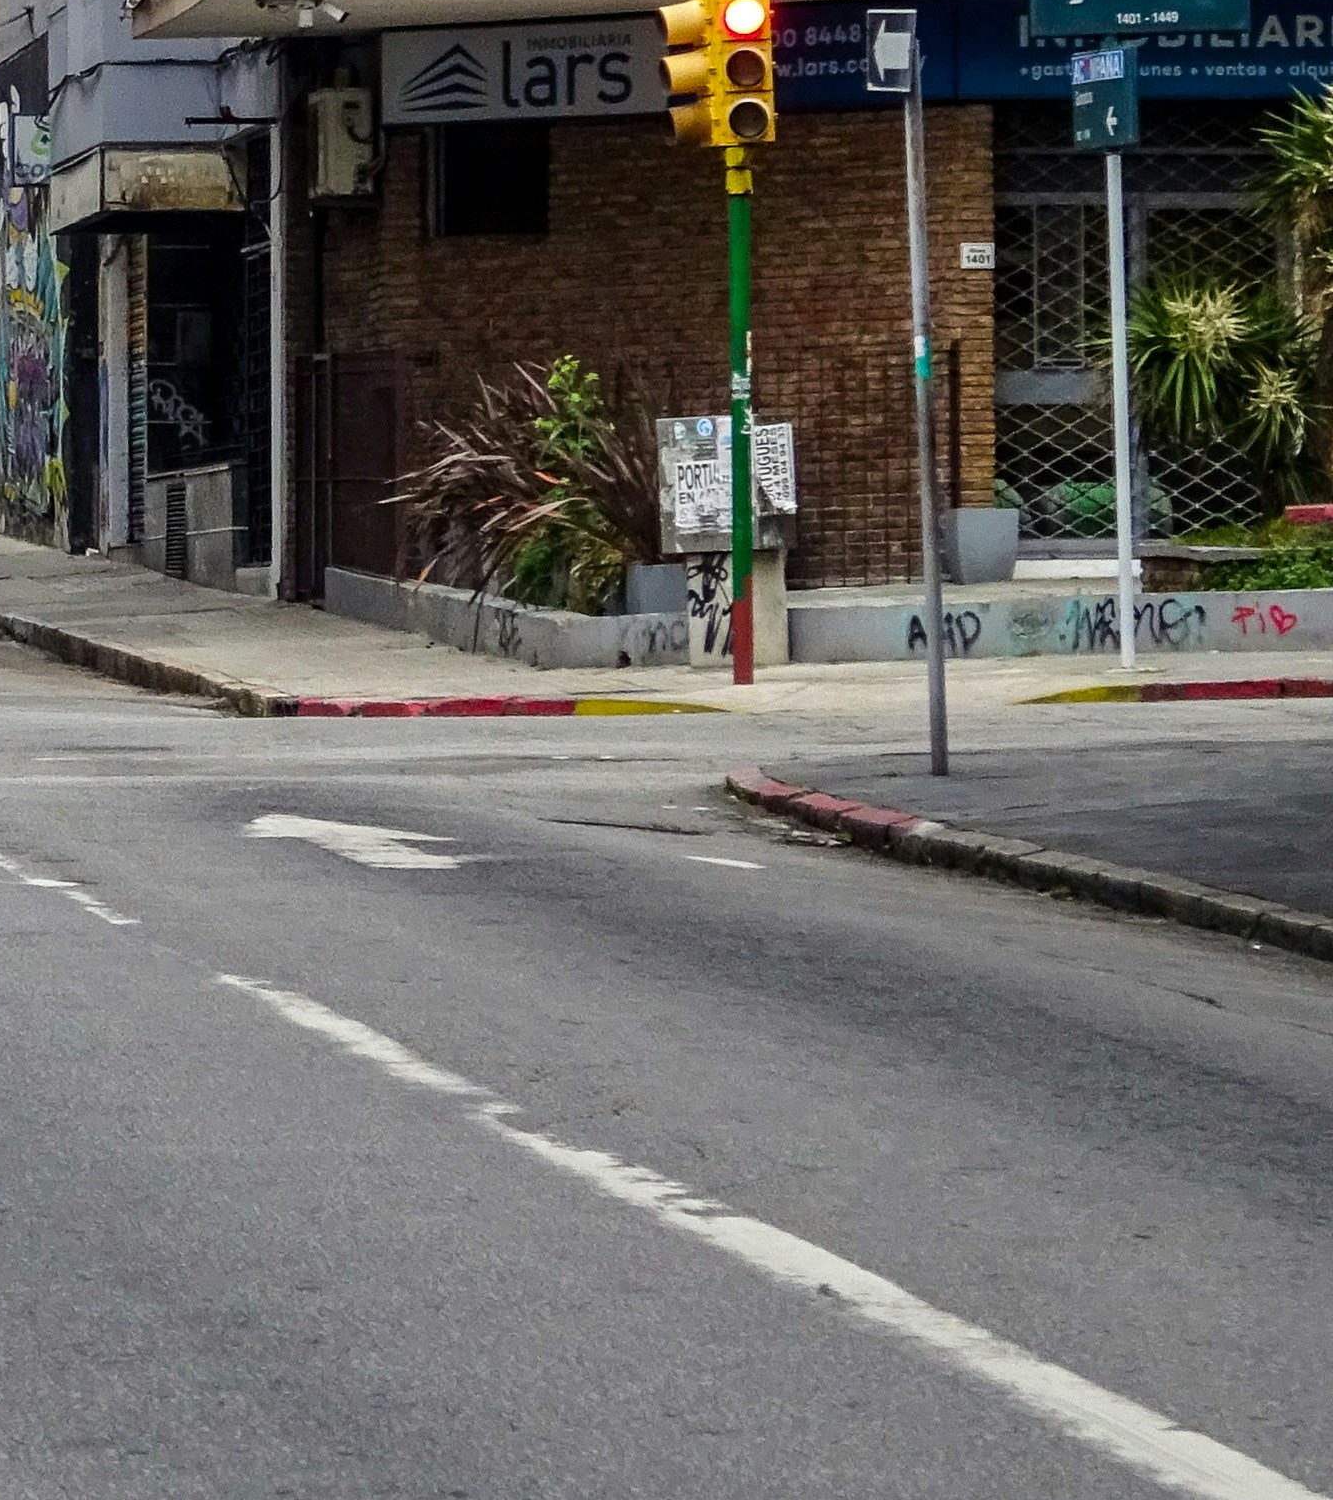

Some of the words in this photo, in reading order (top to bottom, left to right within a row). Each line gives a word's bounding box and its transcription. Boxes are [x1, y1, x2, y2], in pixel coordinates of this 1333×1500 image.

[1116, 12, 1142, 25] 1401
[1152, 11, 1179, 24] 1449
[527, 33, 633, 51] INMOBILIARIA
[501, 40, 634, 109] lars
[1204, 62, 1267, 77] ventas
[965, 255, 991, 264] 1401
